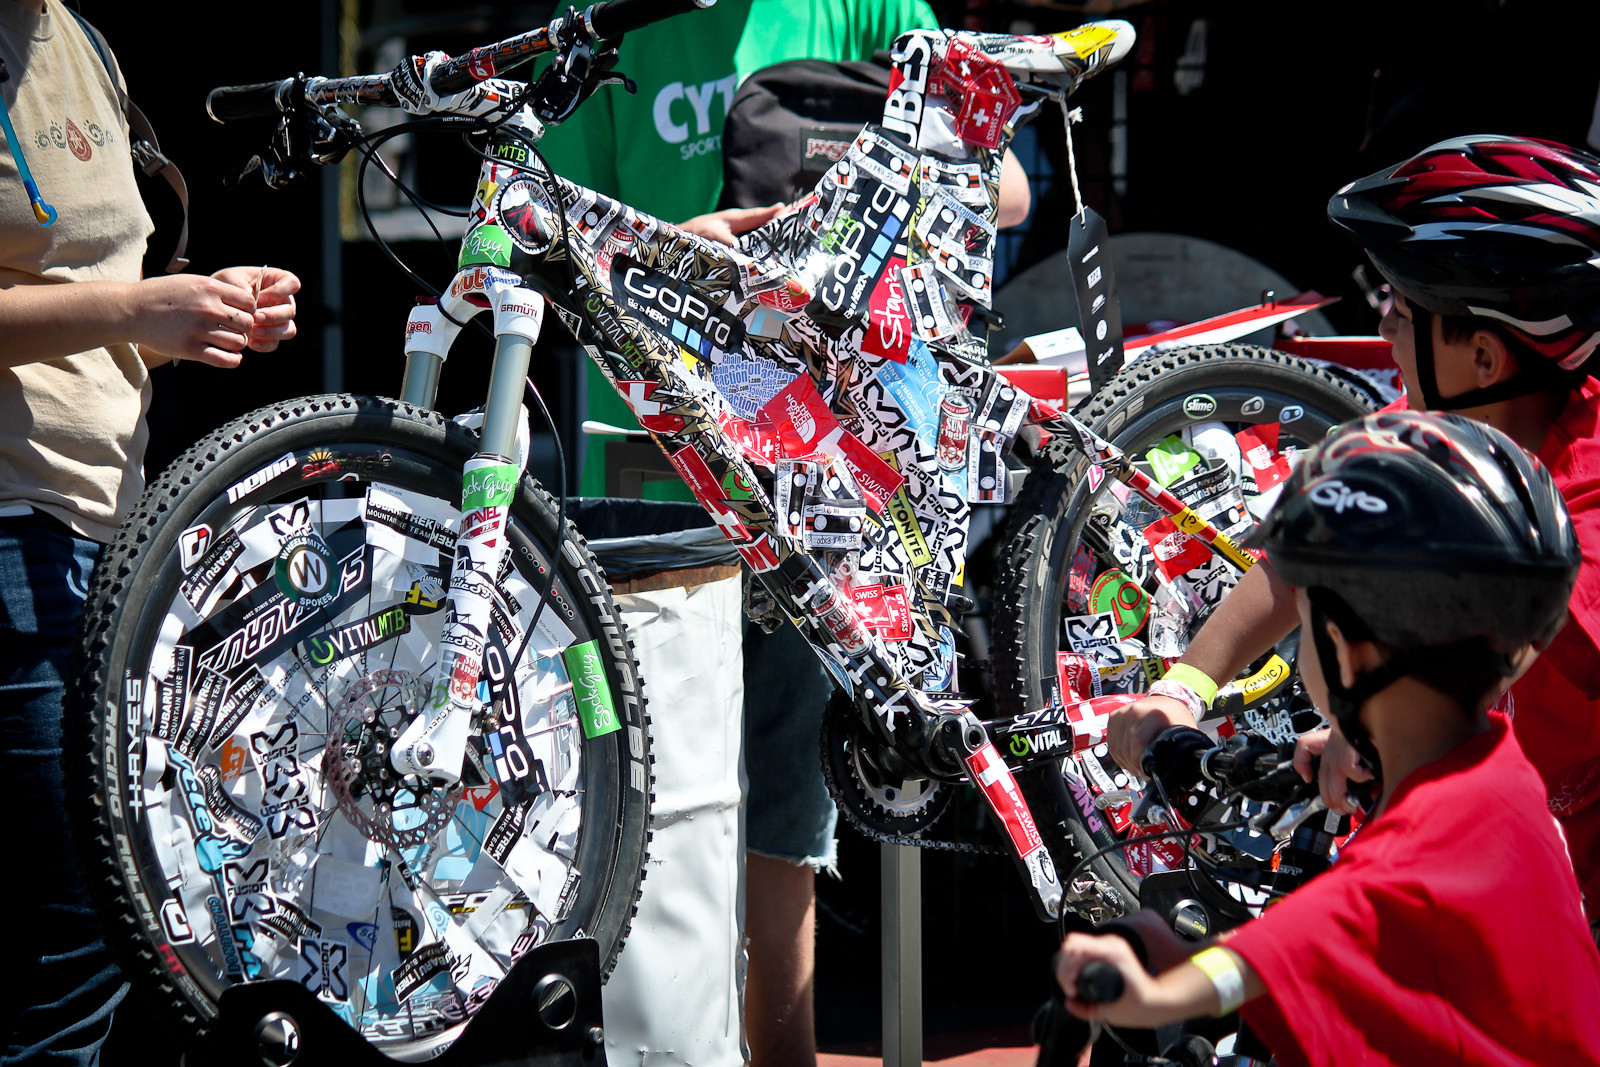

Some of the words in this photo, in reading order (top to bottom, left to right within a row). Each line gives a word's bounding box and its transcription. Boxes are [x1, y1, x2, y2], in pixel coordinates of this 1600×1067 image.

[623, 267, 731, 345] GoPro
[785, 393, 808, 426] NORTH
[785, 406, 802, 432] FACE
[799, 401, 812, 420] THE
[852, 391, 889, 438] FUSION
[1186, 395, 1214, 412] slime
[945, 419, 964, 431] SUN
[859, 472, 890, 500] SWISS
[1309, 478, 1388, 515] Giro
[299, 592, 333, 609] SPOKES
[855, 589, 879, 601] SWISS
[328, 607, 407, 653] VITALMTB
[1072, 635, 1118, 650] FUSION
[560, 539, 645, 795] SCHWALBE
[234, 672, 262, 702] TREK
[158, 686, 175, 739] SUBARU
[179, 703, 205, 754] SUBARU
[126, 679, 143, 823] HAYES
[1026, 729, 1068, 754] VITAL
[1009, 788, 1024, 808] DT
[1020, 810, 1042, 845] SWISS
[494, 831, 516, 865] TREK
[227, 881, 269, 897] FUSION
[207, 897, 242, 976] CHALLENGE
[321, 941, 332, 999] FUSION
